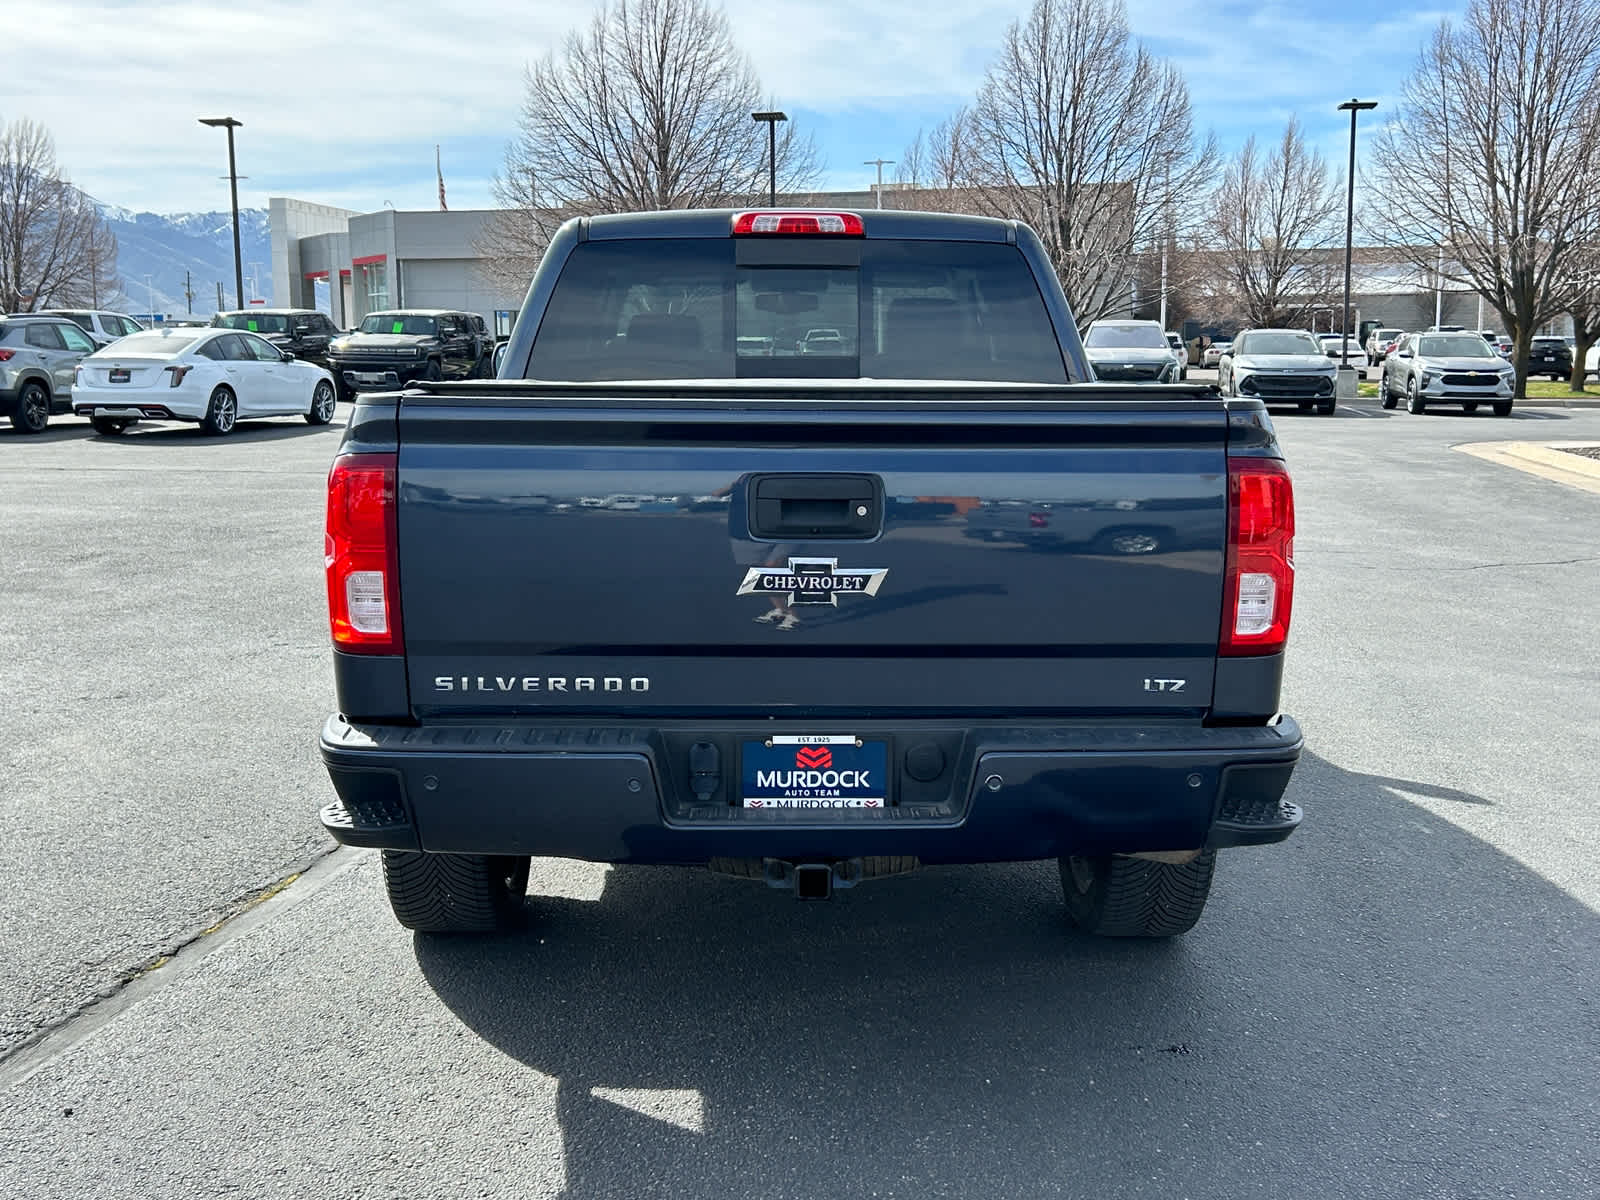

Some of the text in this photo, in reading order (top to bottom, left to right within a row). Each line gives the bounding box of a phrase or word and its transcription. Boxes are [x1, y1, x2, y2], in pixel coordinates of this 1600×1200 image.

[763, 576, 863, 589] CHEVROLET
[434, 676, 650, 692] SILVERADO
[1143, 678, 1186, 692] LTZ
[757, 770, 870, 788] MURDOCK
[777, 800, 851, 808] MURDOCK
